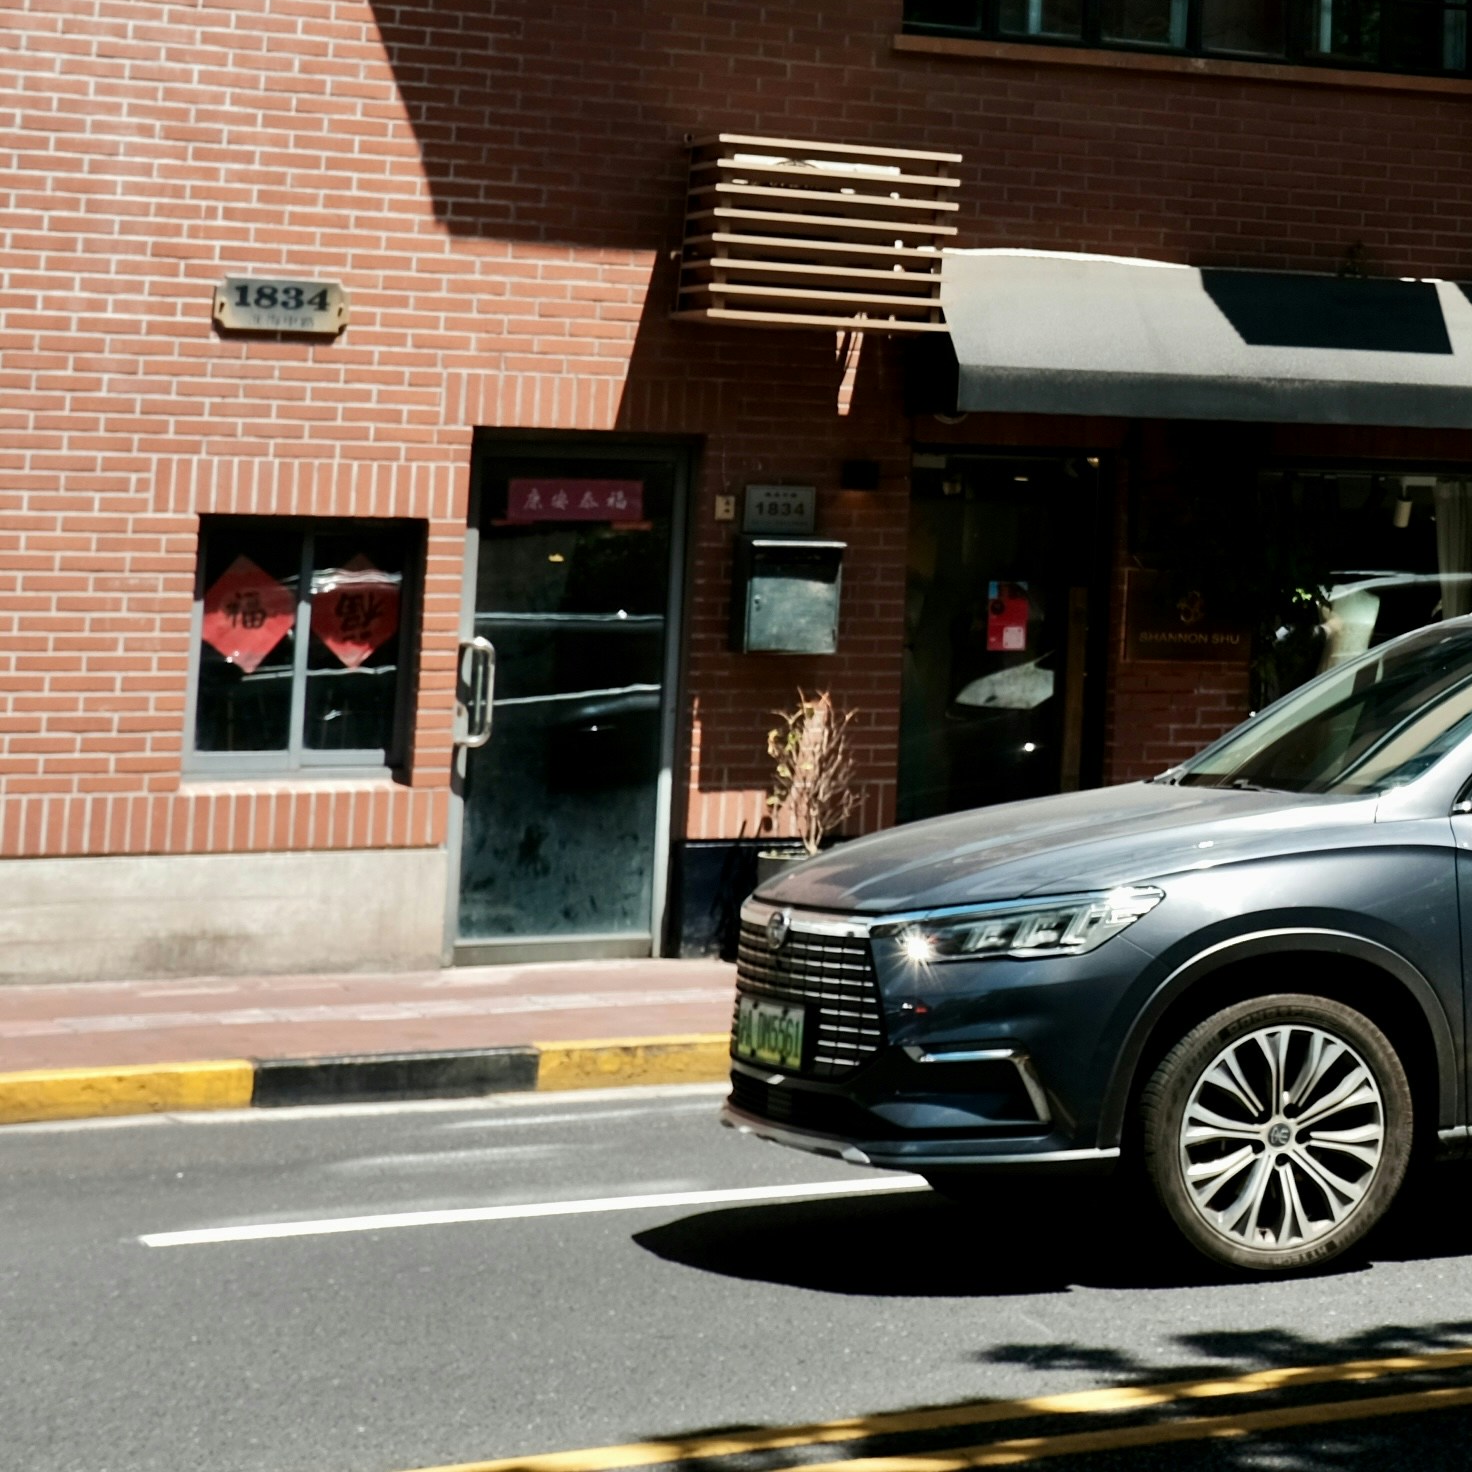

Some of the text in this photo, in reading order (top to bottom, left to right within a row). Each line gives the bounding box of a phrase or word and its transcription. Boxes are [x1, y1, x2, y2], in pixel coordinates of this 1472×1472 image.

[234, 284, 330, 312] 1834
[755, 501, 805, 517] 1834
[226, 591, 267, 630] 福
[1140, 631, 1240, 645] SHANNON SHU
